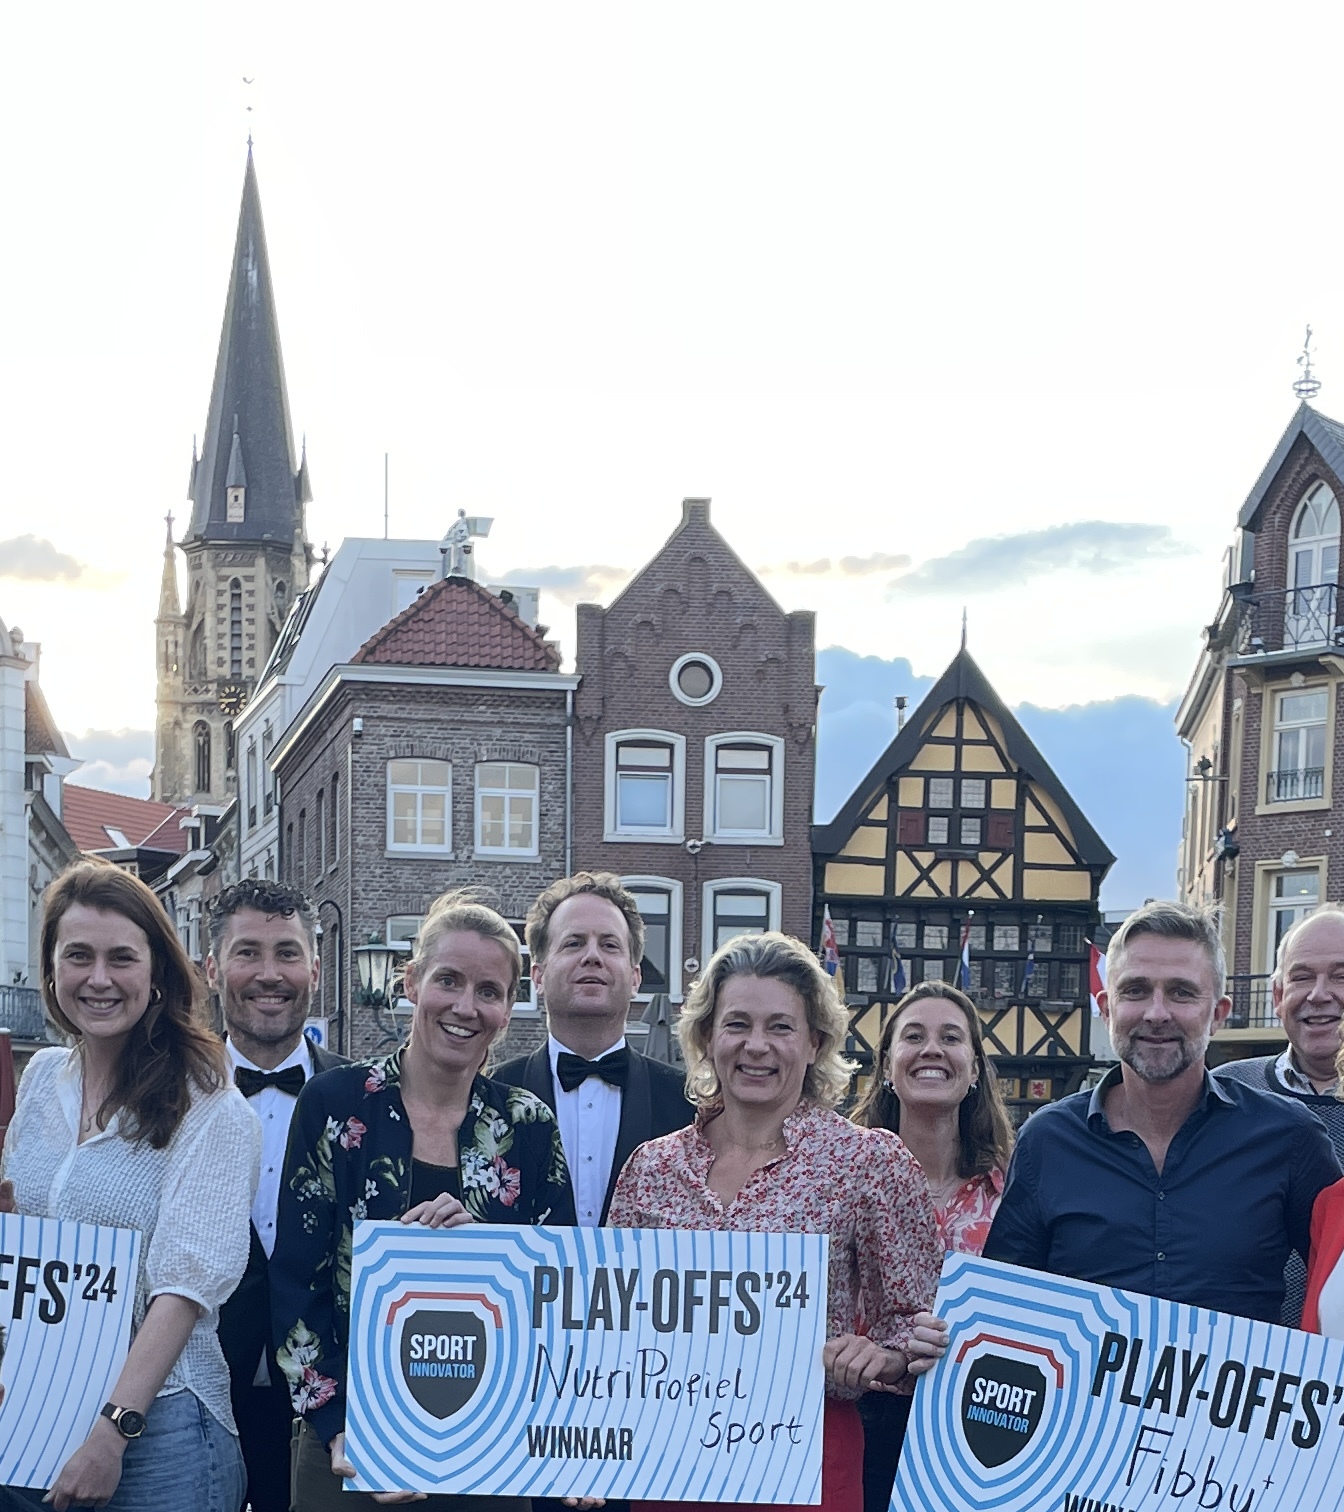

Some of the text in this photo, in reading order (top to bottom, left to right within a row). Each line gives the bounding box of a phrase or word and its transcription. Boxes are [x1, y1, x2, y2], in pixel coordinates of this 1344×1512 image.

[409, 1333, 477, 1361] SPORT
[409, 1361, 475, 1379] INNOVATOR
[971, 1376, 1037, 1415] SPORT
[966, 1404, 1031, 1435] INNOVATOR
[527, 1424, 633, 1461] WINNAAR
